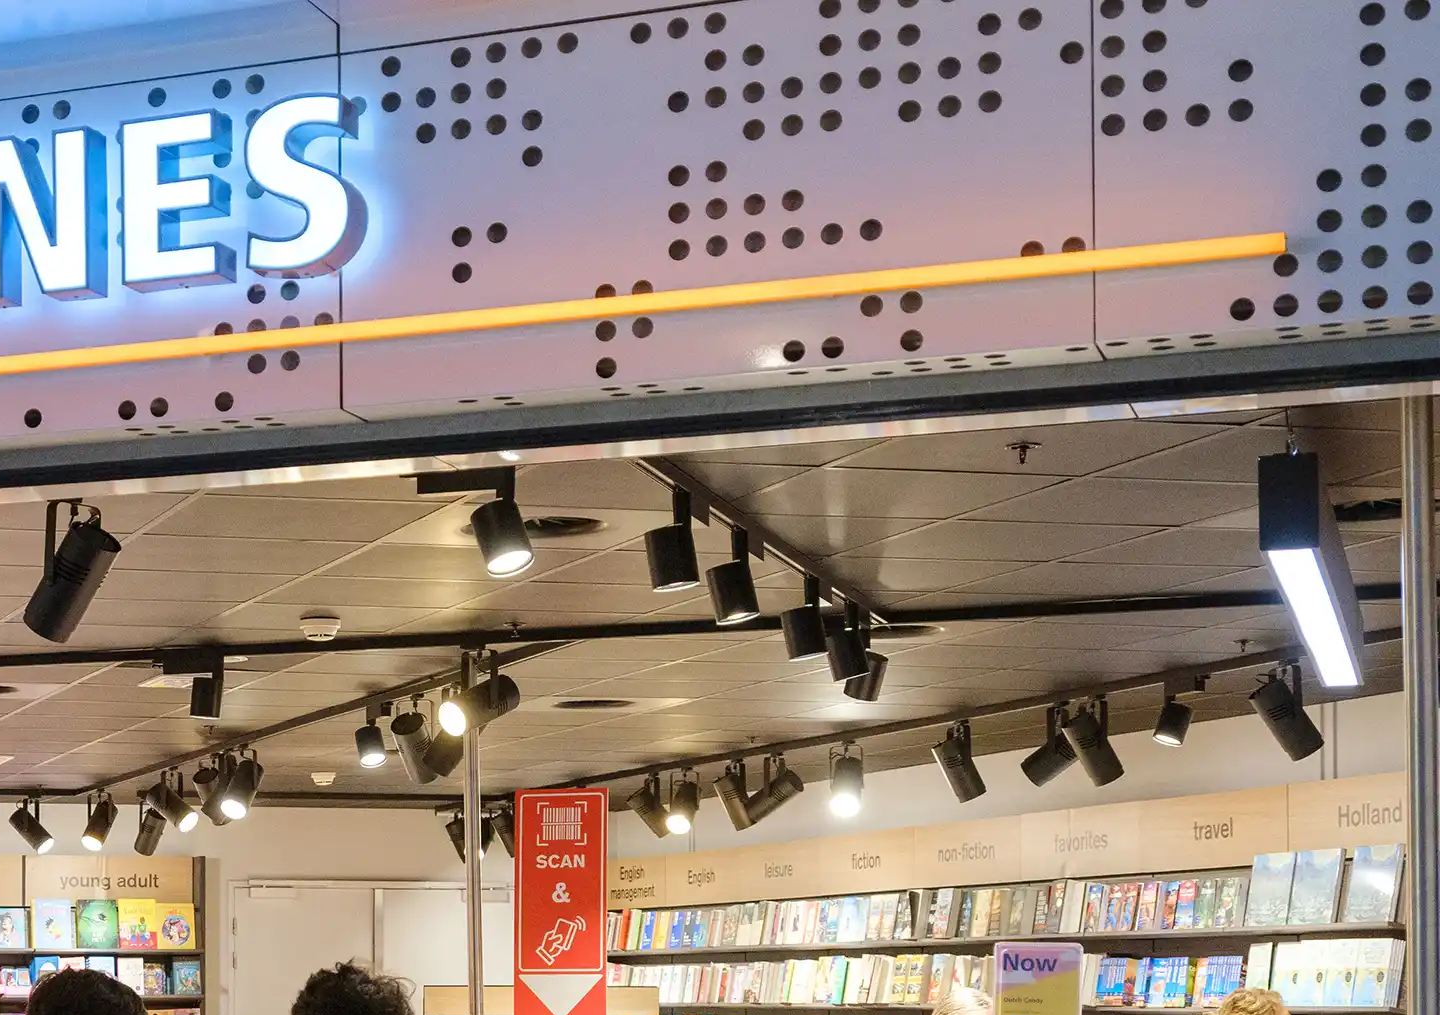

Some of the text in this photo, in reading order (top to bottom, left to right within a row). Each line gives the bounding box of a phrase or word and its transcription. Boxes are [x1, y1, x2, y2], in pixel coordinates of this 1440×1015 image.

[1338, 799, 1403, 828] Holland
[1194, 817, 1234, 840] travel
[1054, 831, 1108, 853] favorites
[938, 842, 996, 863] non-fiction
[536, 855, 585, 869] SCAN
[765, 861, 793, 879] leisure
[852, 853, 881, 871] fiction
[60, 873, 159, 890] young adult
[620, 865, 645, 882] English
[688, 869, 716, 887] English
[552, 882, 570, 903] &
[611, 884, 655, 902] management
[1003, 953, 1058, 972] Now
